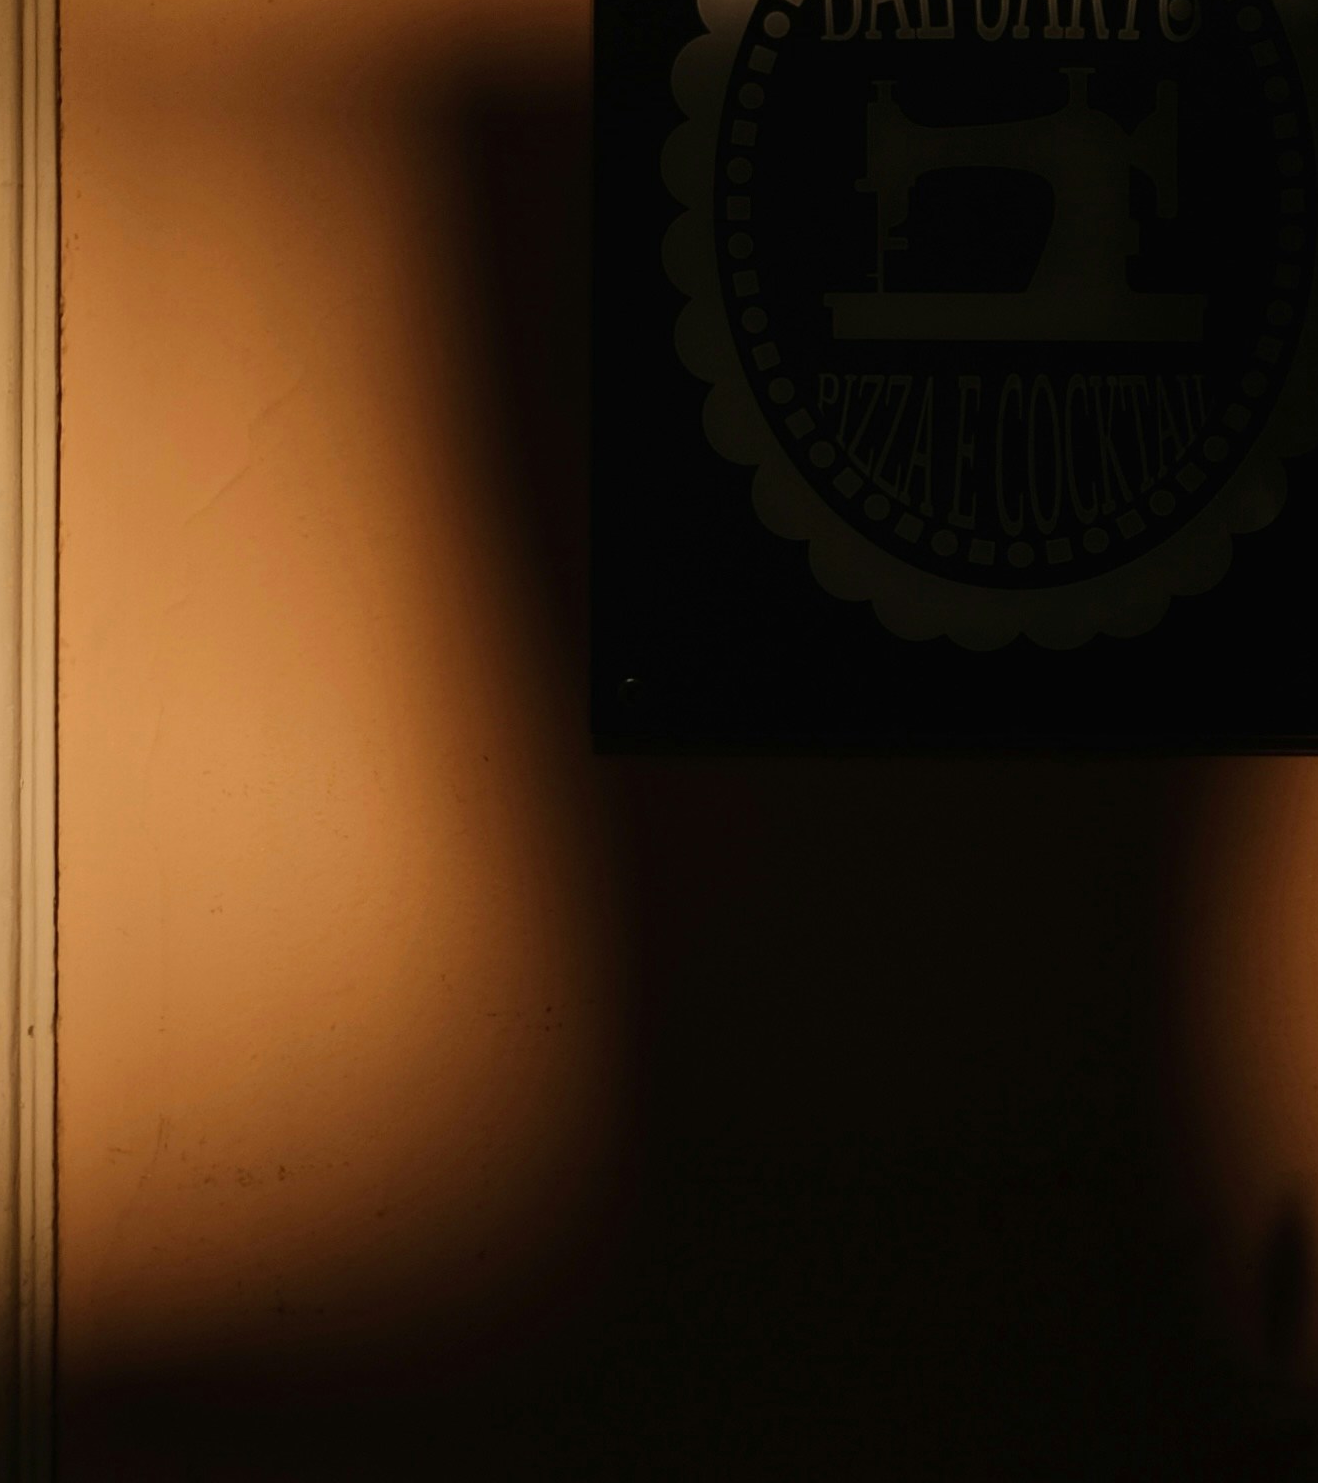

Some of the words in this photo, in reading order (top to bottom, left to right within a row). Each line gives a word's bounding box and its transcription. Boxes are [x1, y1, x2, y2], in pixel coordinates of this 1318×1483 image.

[816, 371, 935, 517] PIZZA
[947, 373, 981, 531] E
[994, 372, 1214, 538] COCKTAIL
